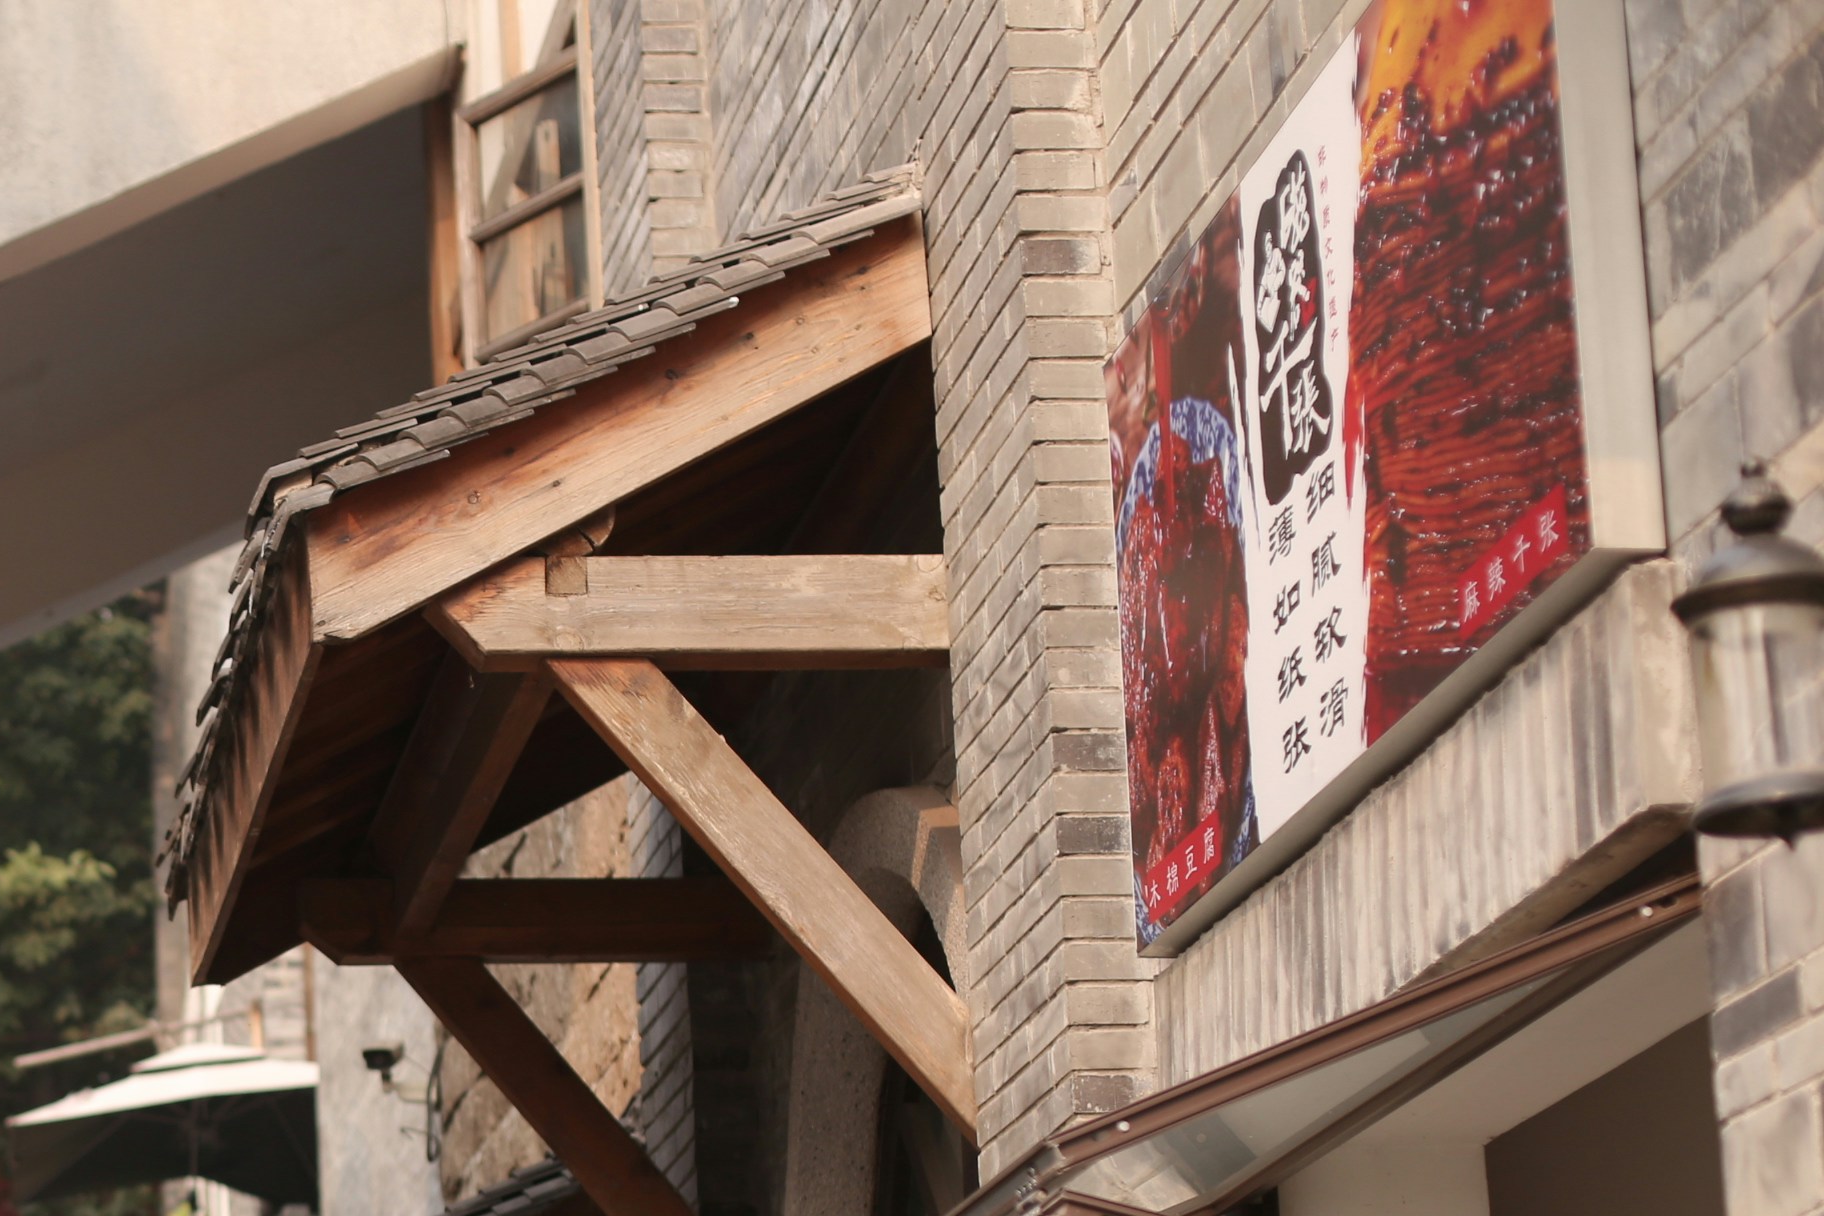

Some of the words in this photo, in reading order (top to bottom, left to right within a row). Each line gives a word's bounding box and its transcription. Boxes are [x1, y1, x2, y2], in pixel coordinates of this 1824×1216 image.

[1268, 503, 1313, 775] 薄如纸张
[1305, 459, 1349, 738] 细腻软滑
[1463, 509, 1560, 623] 麻辣千张
